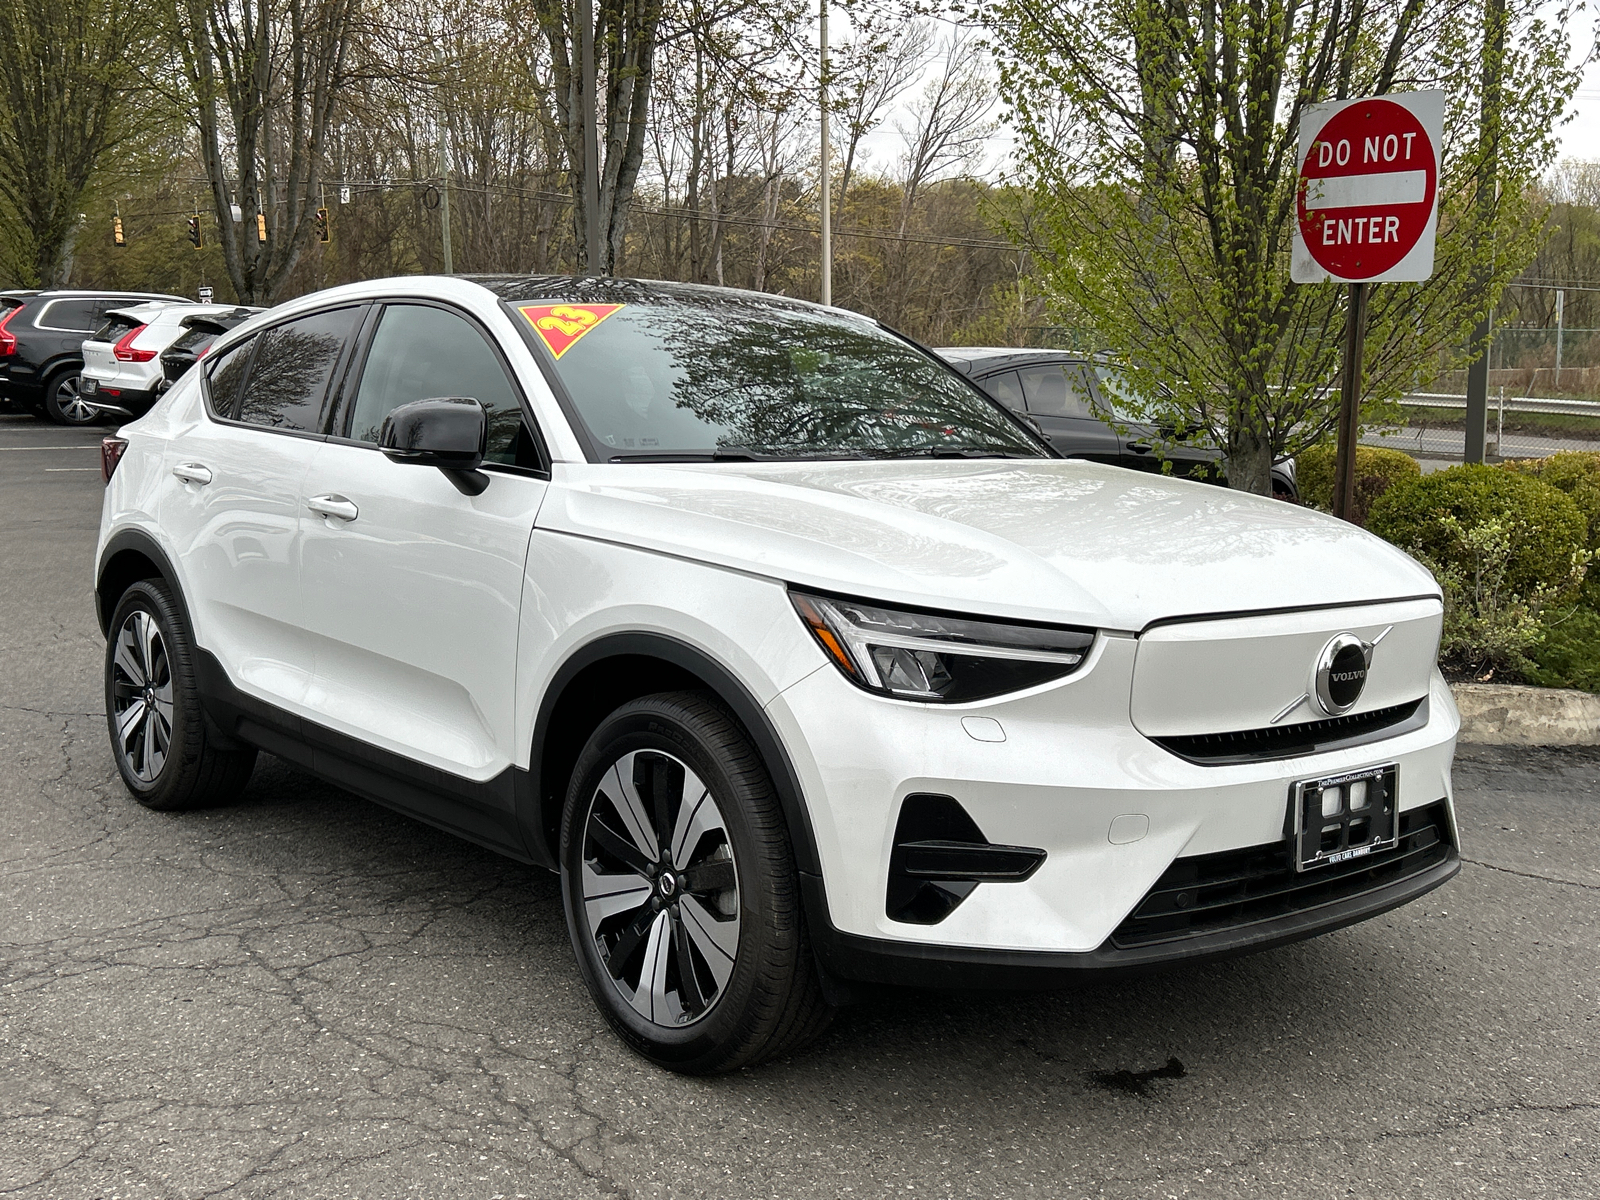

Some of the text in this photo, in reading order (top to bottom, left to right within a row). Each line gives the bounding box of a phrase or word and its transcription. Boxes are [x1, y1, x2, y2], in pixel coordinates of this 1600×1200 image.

[1318, 132, 1416, 168] DO NOT
[1322, 216, 1400, 246] ENTER
[537, 306, 598, 336] 23
[1331, 669, 1365, 682] VOLVO
[1342, 851, 1352, 860] CARS
